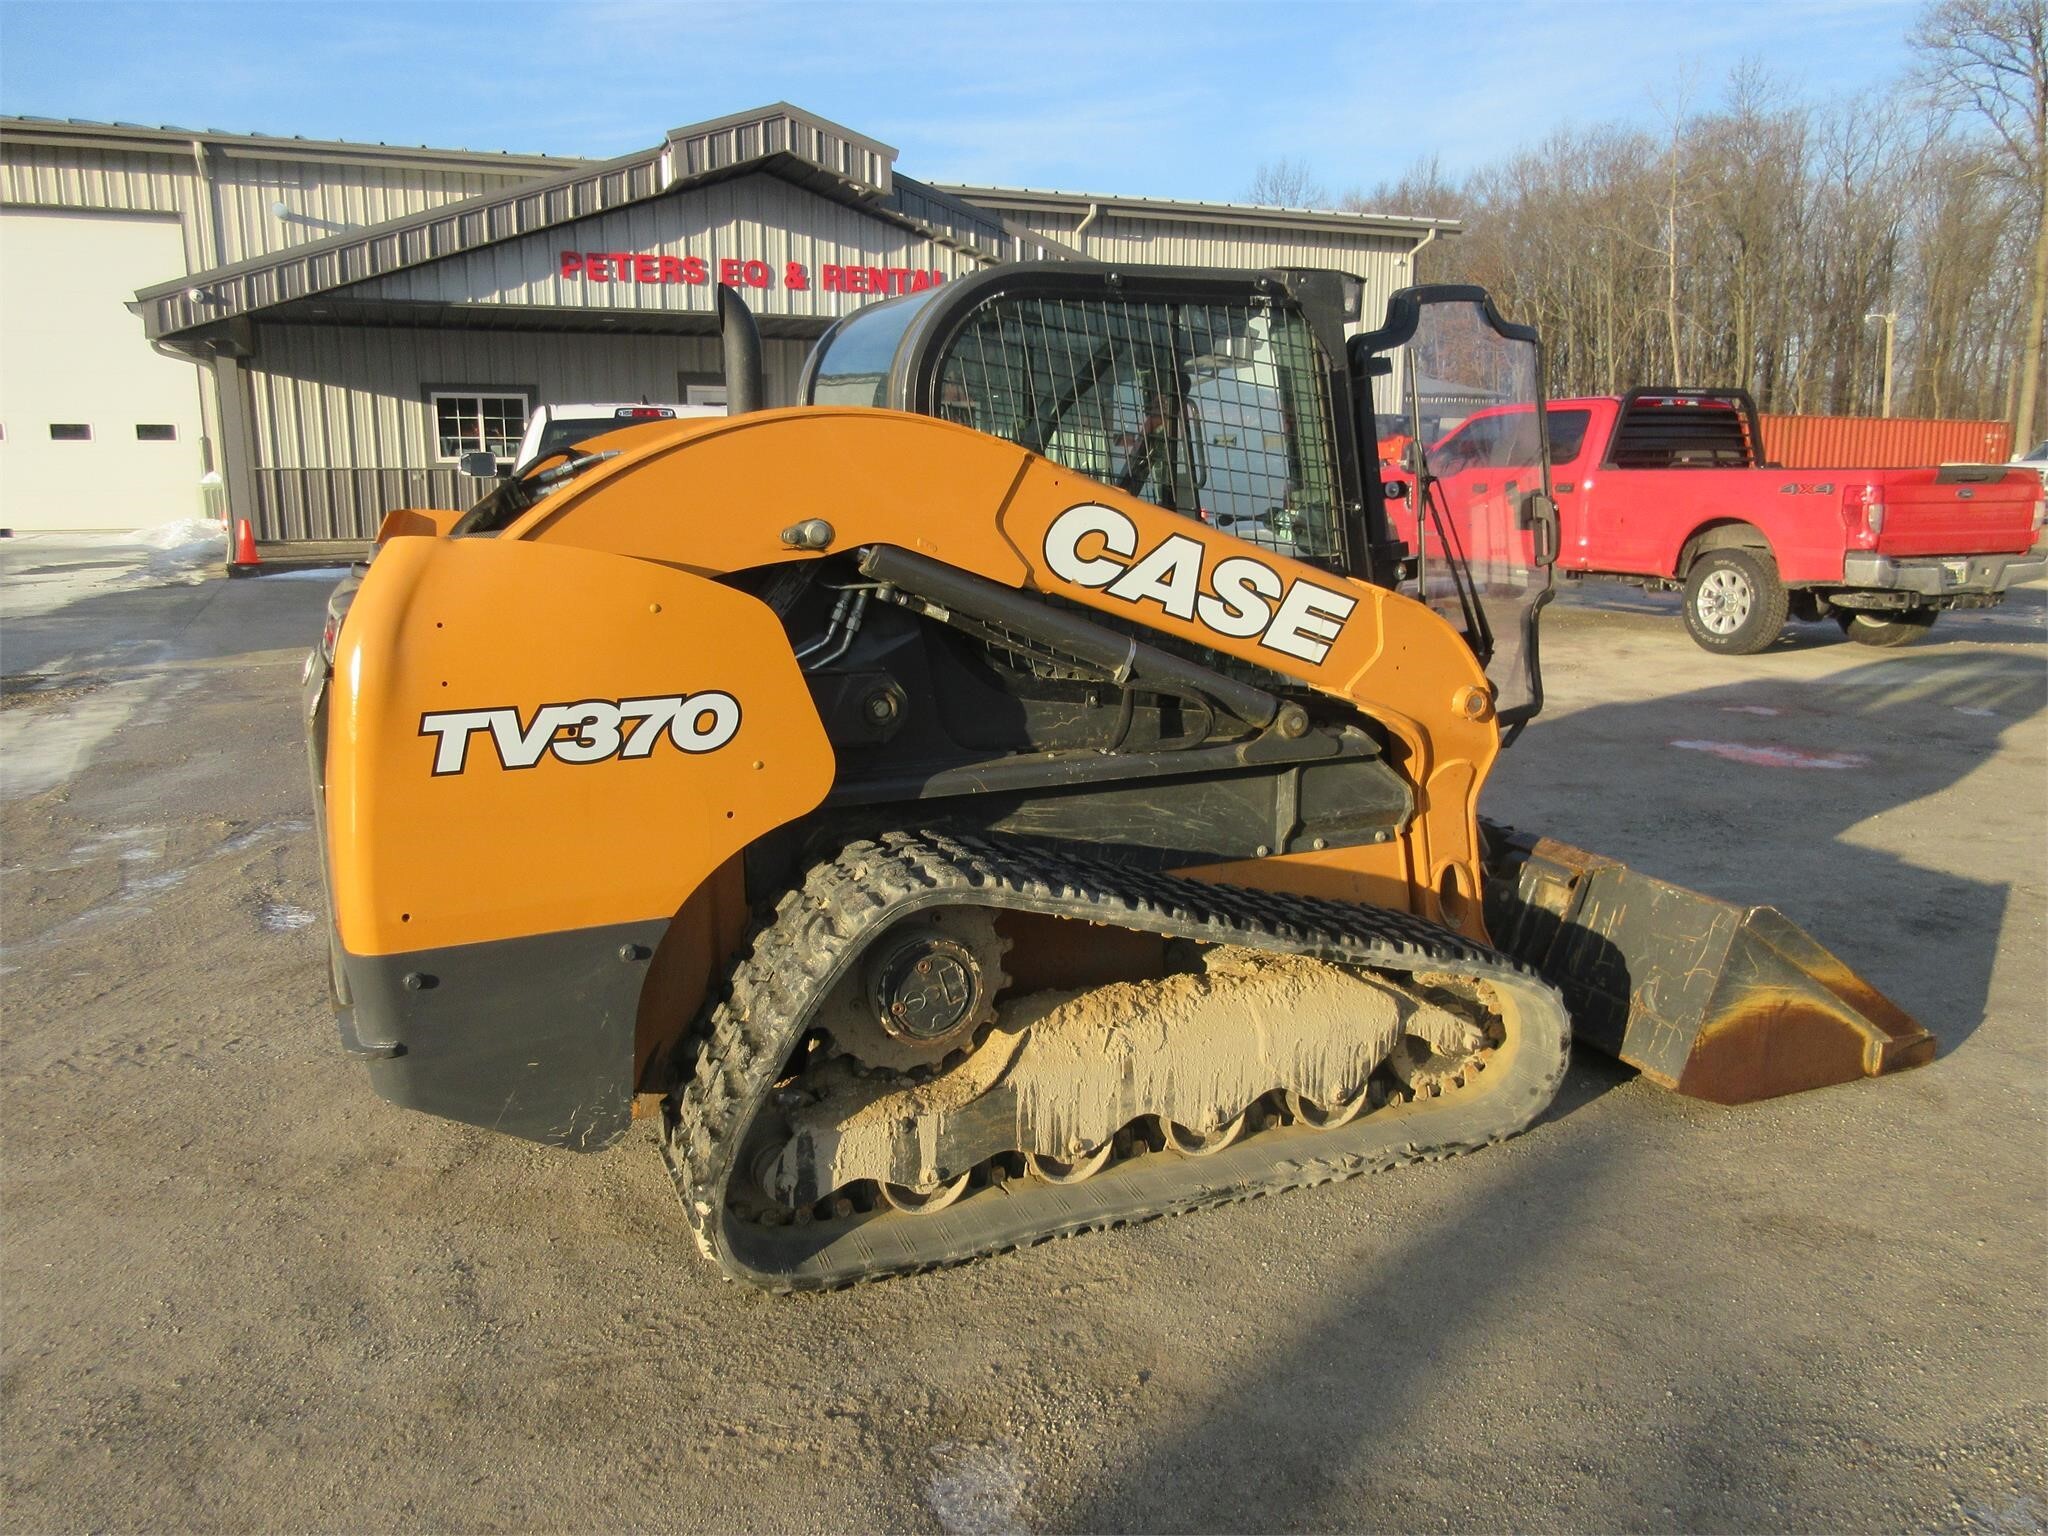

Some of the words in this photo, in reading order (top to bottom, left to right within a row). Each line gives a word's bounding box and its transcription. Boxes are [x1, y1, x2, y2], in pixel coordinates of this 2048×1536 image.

[561, 251, 706, 285] PETERS
[721, 258, 769, 288] EQ
[784, 261, 807, 291] &
[1043, 502, 1359, 667] CASE
[418, 689, 742, 777] TV370
